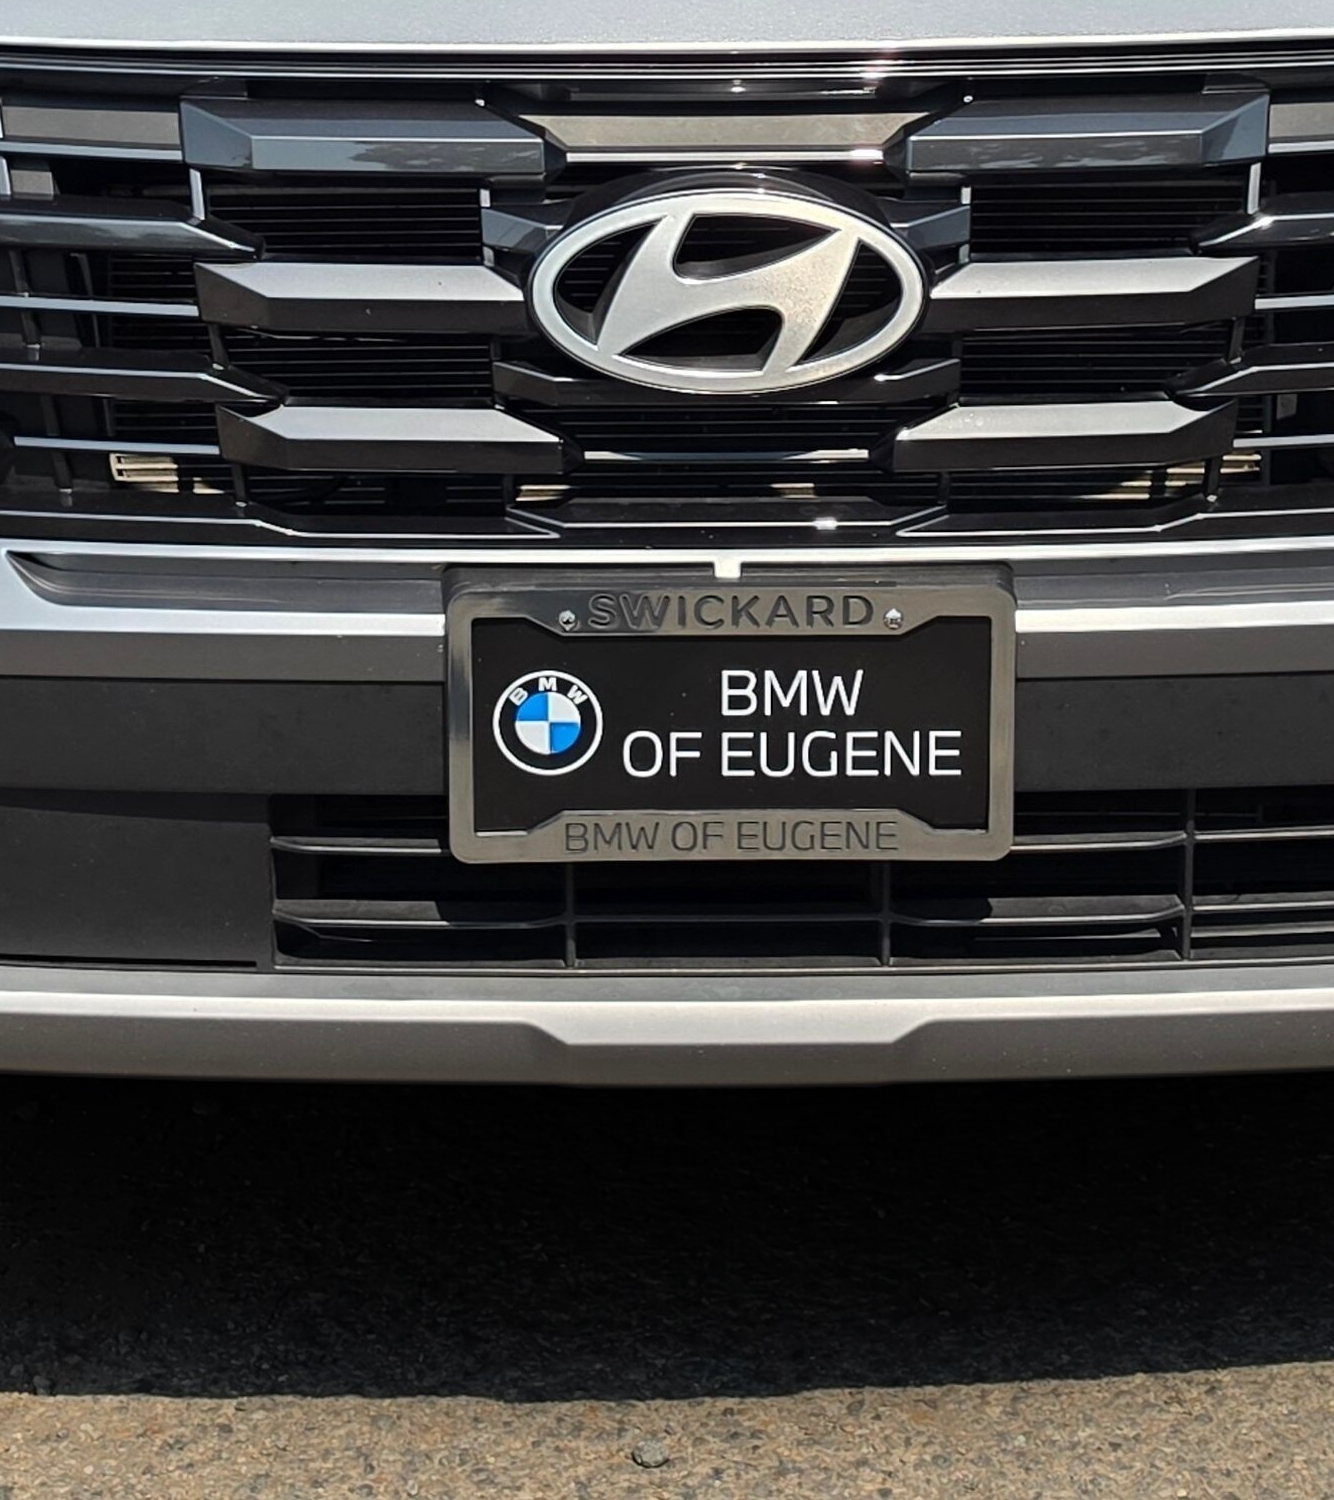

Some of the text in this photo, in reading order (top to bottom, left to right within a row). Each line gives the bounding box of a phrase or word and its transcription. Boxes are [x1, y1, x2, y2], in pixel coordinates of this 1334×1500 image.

[586, 592, 875, 629] SWICKARD
[508, 676, 588, 706] BMW
[720, 669, 864, 717] BMW
[622, 730, 963, 778] OF EUGENE
[565, 820, 899, 854] BMW OF EUGENE
